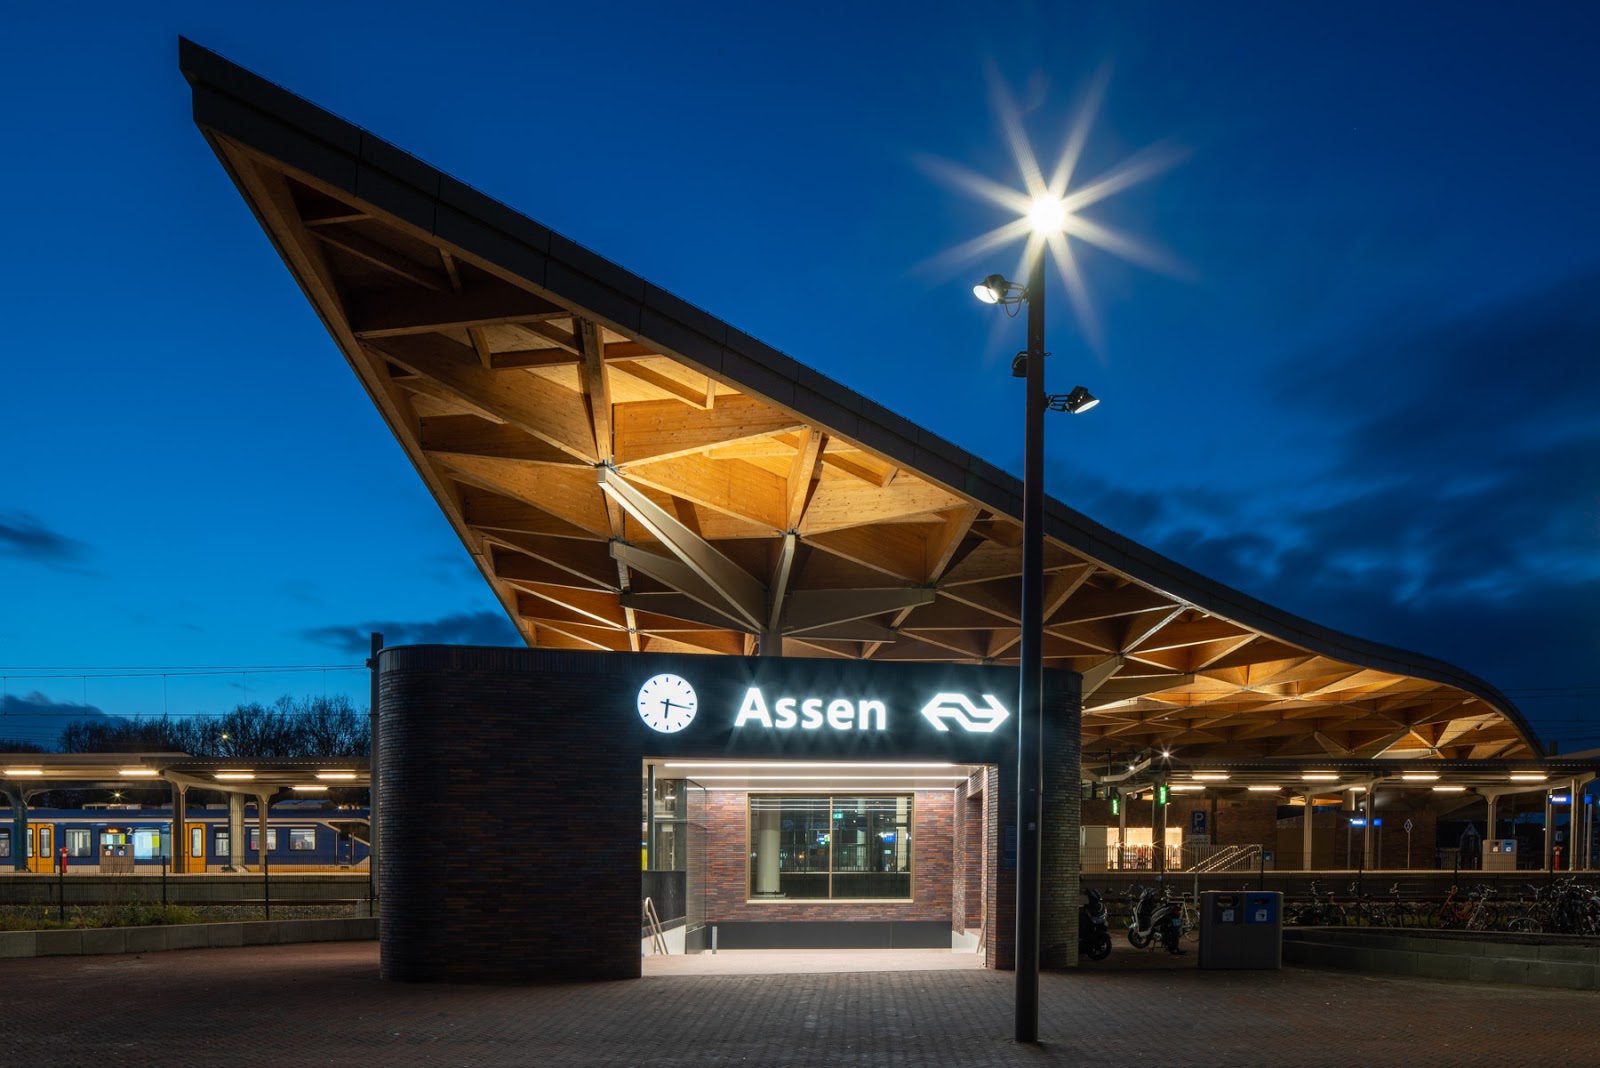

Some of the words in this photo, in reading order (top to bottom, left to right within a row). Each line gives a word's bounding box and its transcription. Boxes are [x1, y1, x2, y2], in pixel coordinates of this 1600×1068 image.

[734, 687, 886, 730] Assen
[1194, 812, 1204, 825] P
[127, 827, 133, 836] 2
